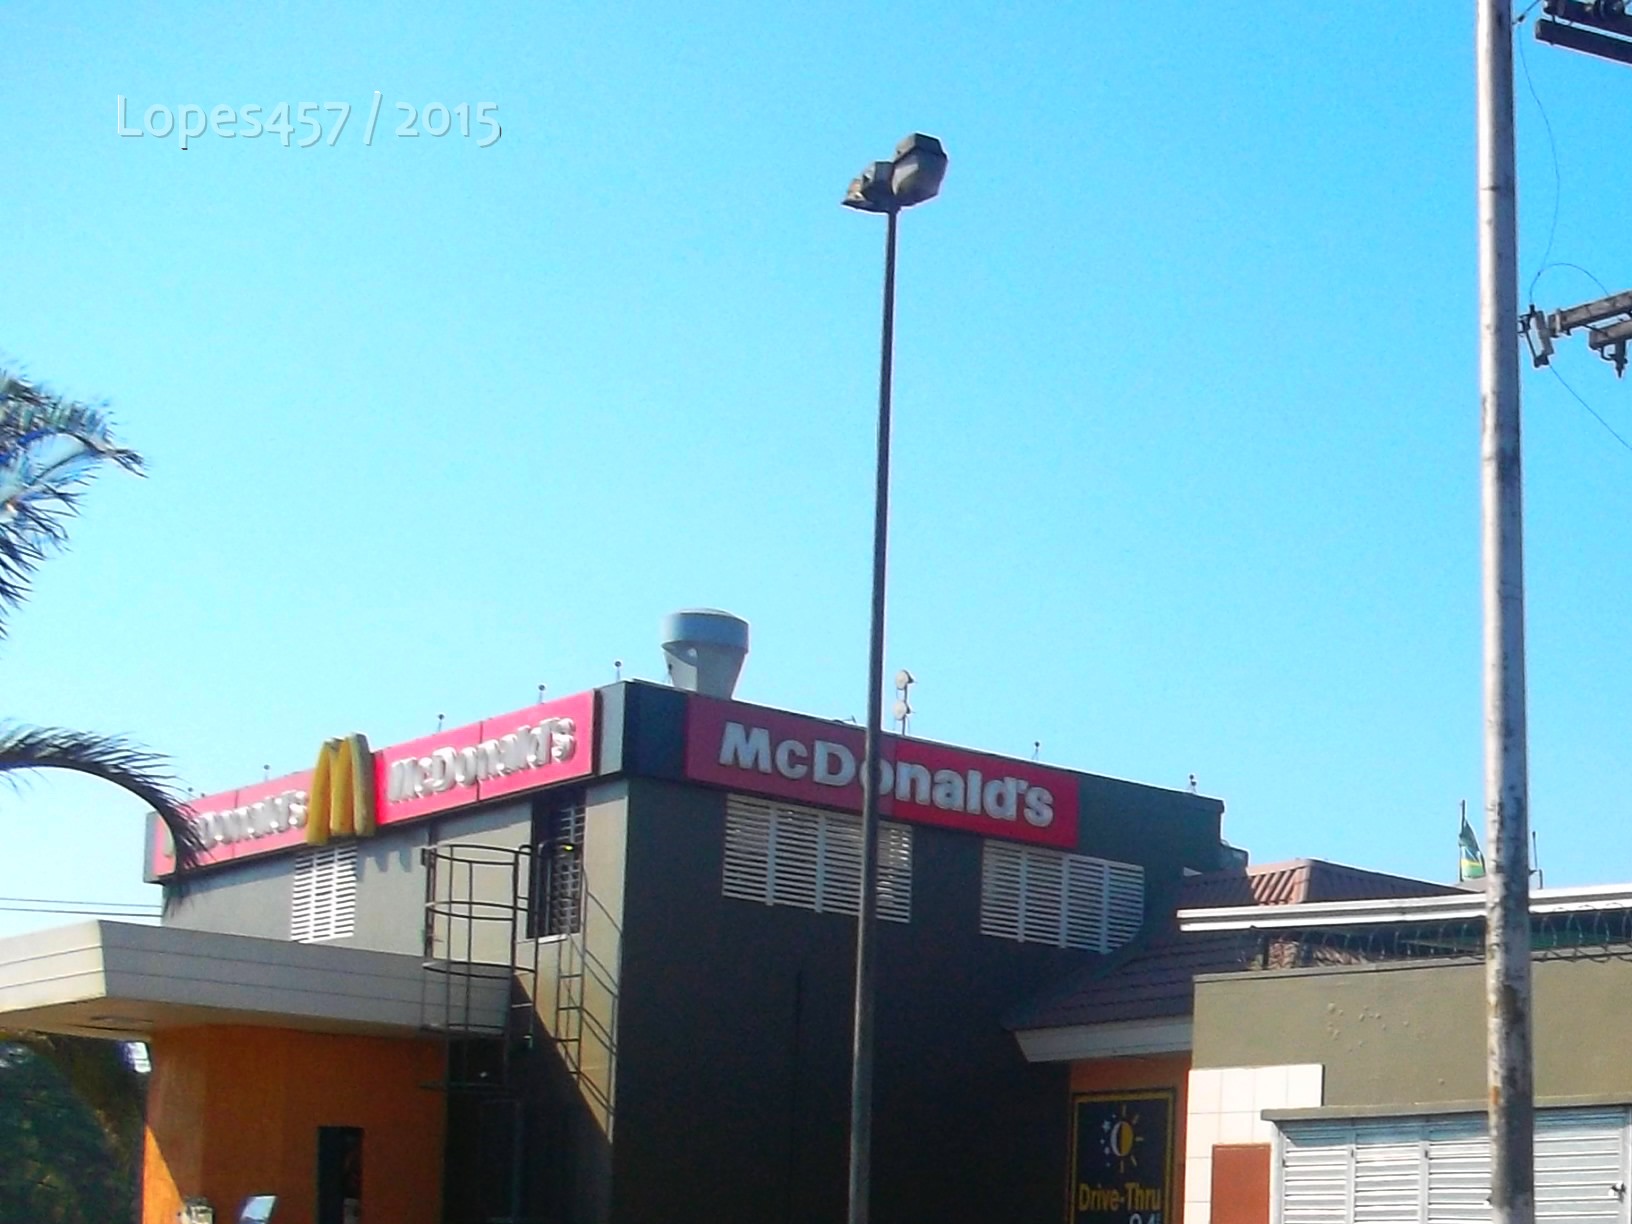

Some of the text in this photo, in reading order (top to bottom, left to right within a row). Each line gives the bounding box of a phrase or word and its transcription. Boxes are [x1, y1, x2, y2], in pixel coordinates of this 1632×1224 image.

[388, 717, 577, 804] McDonald's
[718, 721, 1055, 828] McDonald's
[1079, 1182, 1161, 1212] Drive-Thru
